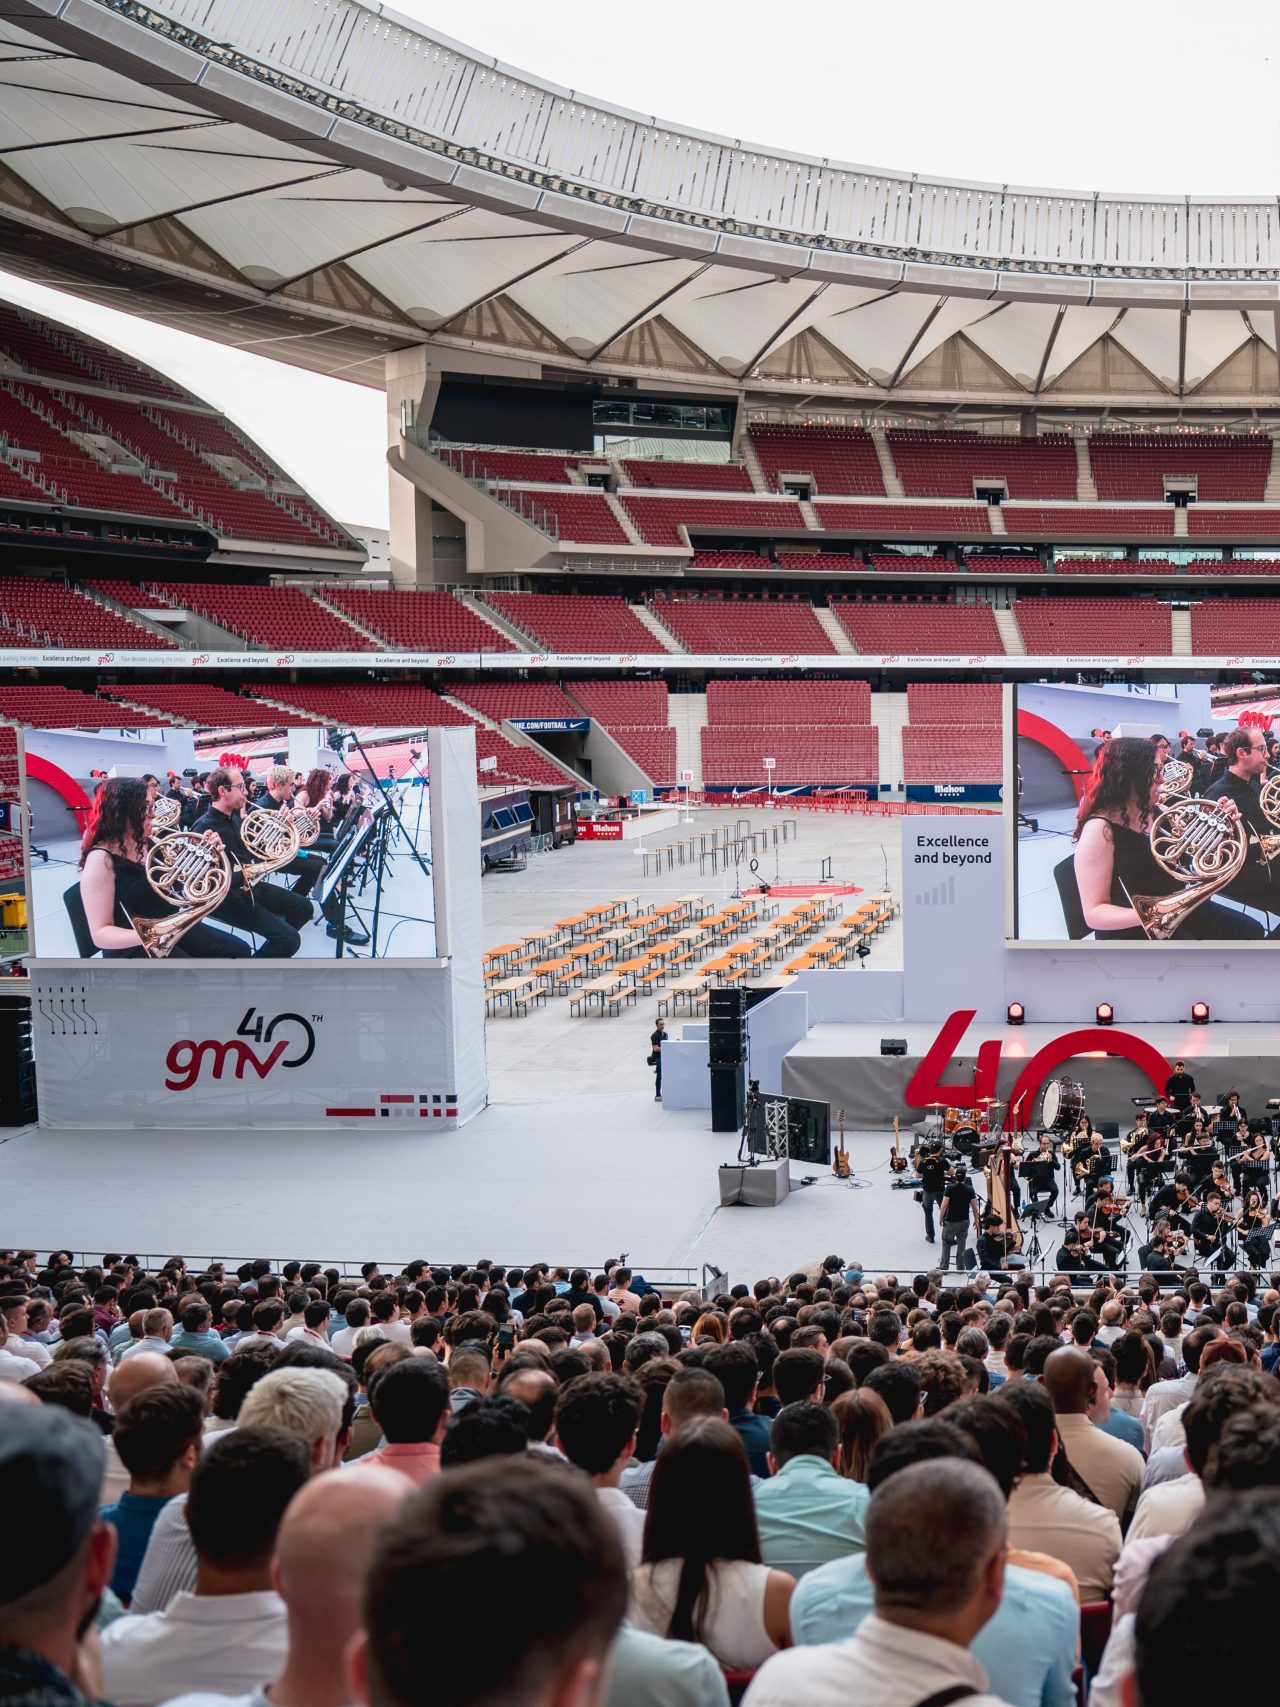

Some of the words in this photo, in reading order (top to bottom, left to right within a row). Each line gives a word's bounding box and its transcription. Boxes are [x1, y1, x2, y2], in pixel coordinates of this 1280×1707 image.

[934, 785, 965, 793] Mahou
[917, 835, 989, 847] Excellence
[914, 852, 938, 863] and
[943, 852, 992, 867] beyond
[165, 1040, 290, 1091] gmv
